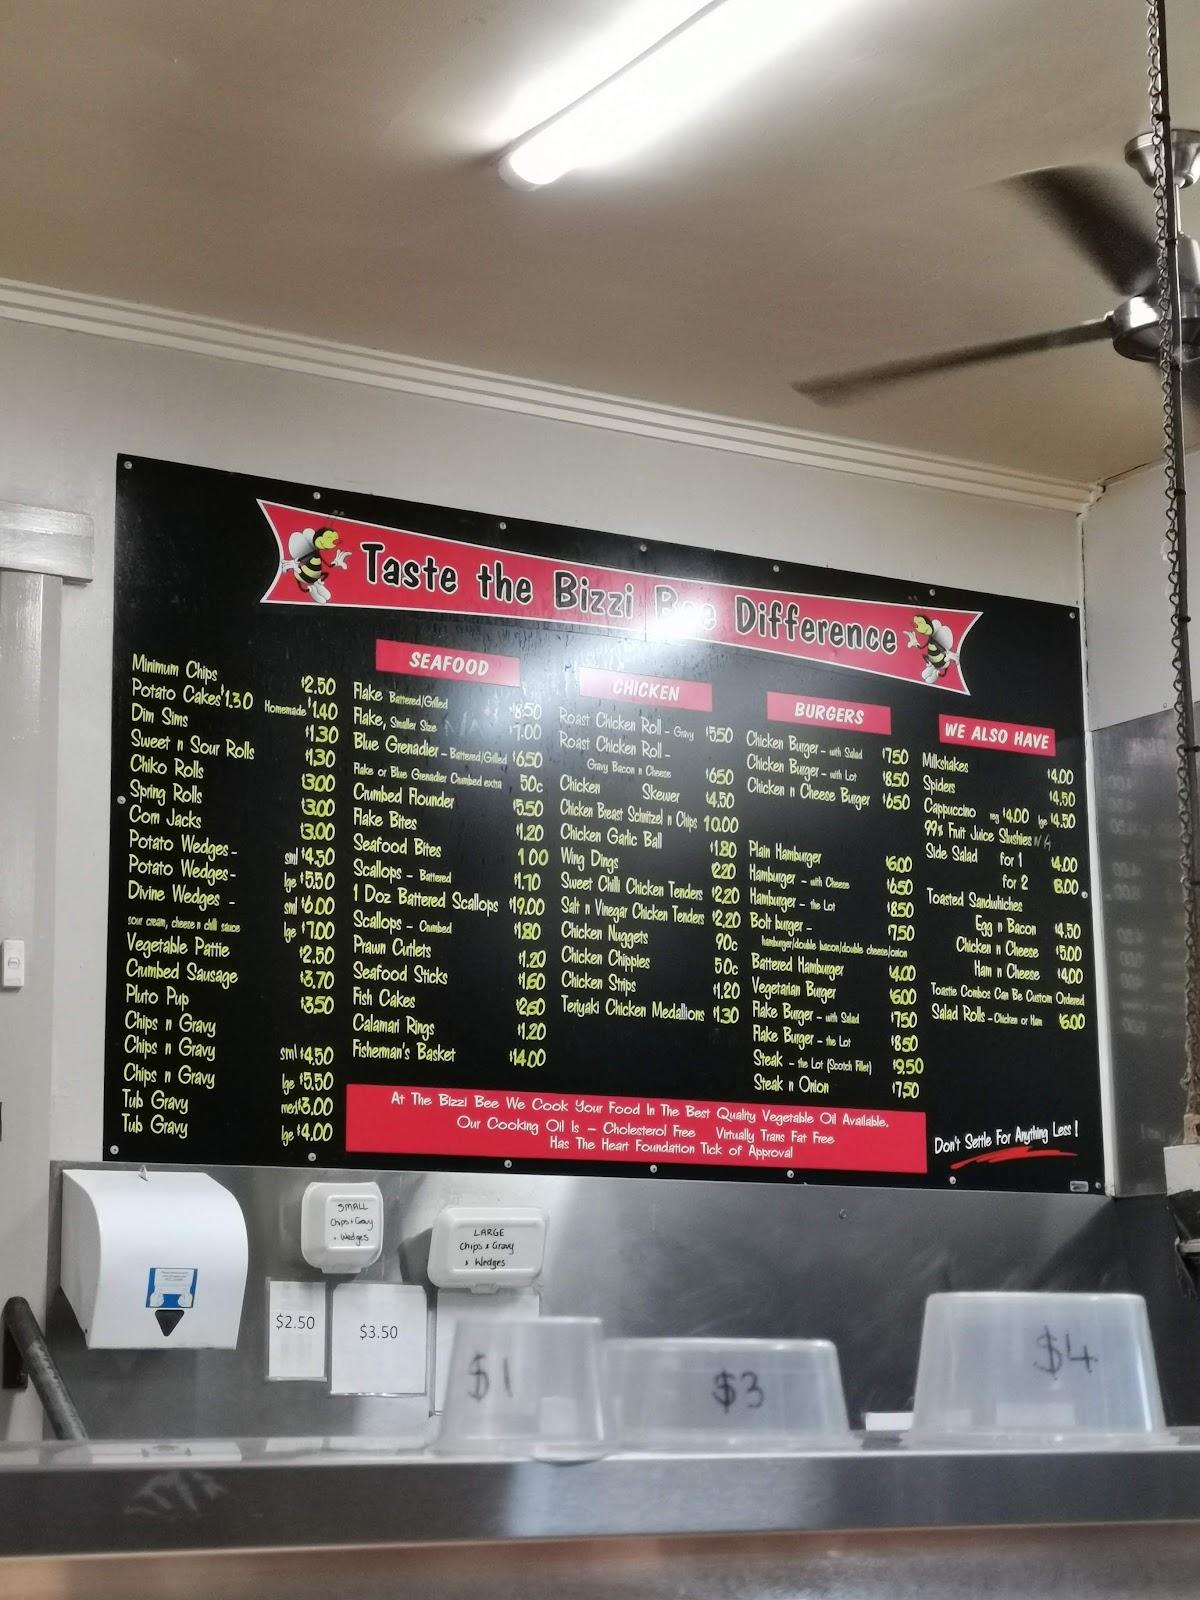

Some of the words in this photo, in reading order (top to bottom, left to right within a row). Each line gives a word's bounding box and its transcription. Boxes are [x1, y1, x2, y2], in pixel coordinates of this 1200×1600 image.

[360, 542, 458, 595] Taste
[477, 560, 533, 606] the
[554, 570, 633, 618] Bizzi
[735, 595, 898, 655] Difference
[132, 653, 179, 677] Minimum
[186, 660, 217, 685] Chips
[301, 675, 336, 695] $2.50
[409, 651, 488, 675] SEAFOOD
[132, 678, 176, 700] Potato
[183, 685, 221, 707] Cakes
[265, 700, 307, 716] Homemade
[308, 696, 338, 720] $1.40
[354, 682, 383, 701] Flake
[612, 678, 680, 702] CHICKEN
[132, 703, 154, 723] Dim
[162, 707, 188, 727] Sims
[795, 702, 864, 724] BURGERS
[131, 728, 171, 750] Sweet
[177, 739, 183, 751] n
[190, 735, 220, 756] Sour
[226, 739, 255, 760] Rolls
[945, 723, 966, 738] WE
[971, 726, 1008, 744] ALSO
[1014, 731, 1049, 749] HAVE
[130, 754, 167, 774] Chiko
[174, 758, 204, 779] Rolls
[923, 752, 968, 773] Milkshakes
[130, 779, 166, 806] Spring
[173, 783, 202, 804] Rolls
[353, 782, 402, 804] Crumbed
[409, 787, 454, 809] Flounder
[560, 774, 600, 794] Chicken
[642, 783, 680, 803] Skewer
[923, 775, 955, 795] Spiders
[924, 797, 976, 819] Cappuccino
[560, 823, 601, 842] Chicken
[607, 827, 637, 846] Garlic
[643, 831, 662, 849] Ball
[749, 840, 770, 858] Plain
[776, 843, 822, 868] Hamburger
[128, 880, 165, 901] Divine
[172, 884, 220, 911] Wedges
[353, 883, 358, 901] 1
[365, 884, 391, 903] Doz
[397, 887, 446, 908] Battered
[452, 891, 498, 917] Scallops
[927, 887, 964, 906] Toasted
[969, 892, 1023, 912] Sandwhiches
[561, 921, 602, 940] Chicken
[608, 924, 648, 949] Nuggets
[716, 933, 738, 951] 90c
[975, 914, 992, 937] Egg
[997, 922, 1002, 932] n
[1006, 918, 1036, 936] Bacon
[127, 932, 188, 958] Vegetable
[195, 936, 230, 957] Pattie
[299, 945, 335, 964] $2.50
[353, 934, 386, 954] Prawn
[392, 938, 431, 958] Cutlets
[126, 958, 179, 979] Crumbed
[187, 962, 238, 989] Sausage
[300, 970, 334, 989] $3.70
[751, 952, 792, 972] Battered
[798, 956, 844, 981] Hamburger
[126, 983, 158, 1004] Pluto
[167, 986, 189, 1012] Pup
[353, 986, 372, 1005] Fish
[379, 989, 415, 1008] Cakes
[752, 976, 800, 1000] Vegetarian
[805, 980, 836, 1004] Burger
[561, 995, 599, 1017] Teriyaki
[605, 998, 646, 1017] Chicken
[652, 1001, 705, 1021] Medallions
[125, 1010, 158, 1035] Chips
[166, 1019, 172, 1031] n
[179, 1013, 216, 1038] Gravy
[353, 1013, 400, 1033] Calamari
[406, 1016, 435, 1041] Rings
[353, 1039, 410, 1060] Fisherman's
[416, 1042, 456, 1062] Basket
[753, 1049, 783, 1067] Steak
[391, 1091, 405, 1104] At
[411, 1092, 432, 1105] The
[474, 1095, 500, 1108] Bee
[506, 1096, 525, 1109] We
[532, 1098, 568, 1111] Cook
[575, 1099, 603, 1113] Your
[608, 1101, 640, 1115] Food
[647, 1103, 655, 1115] In
[660, 1104, 680, 1116] The
[685, 1104, 711, 1118] Best
[717, 1107, 756, 1123] Quality
[762, 1109, 814, 1126] Vegetable
[820, 1112, 836, 1124] Oil
[843, 1113, 888, 1127] Available.
[122, 1113, 143, 1134] Tub
[150, 1114, 188, 1139] Gravy
[457, 1115, 481, 1128] Our
[487, 1117, 538, 1135] Cooking
[546, 1119, 564, 1132] Oil
[572, 1120, 579, 1133] Is
[603, 1122, 666, 1136] Cholesterol
[673, 1125, 696, 1137] Free
[716, 1127, 754, 1143] Virtually
[760, 1129, 785, 1142] Trans
[792, 1130, 807, 1143] Fat
[813, 1131, 835, 1144] Free
[550, 1136, 569, 1149] Has
[576, 1137, 595, 1149] The
[602, 1138, 629, 1151] Heart
[636, 1139, 695, 1154] Foundation
[700, 1142, 722, 1155] Tick
[729, 1145, 743, 1156] of
[749, 1144, 793, 1160] Approval
[934, 1136, 960, 1154] Don't
[965, 1132, 992, 1150] Settle
[996, 1129, 1011, 1146] For
[1015, 1126, 1048, 1145] Anything
[337, 1202, 368, 1212] SMALL
[341, 1232, 369, 1246] Wedges
[474, 1228, 504, 1236] LARGE
[460, 1242, 482, 1254] Chips
[475, 1256, 505, 1270] Wedges
[275, 1313, 315, 1331] $2.50
[359, 1323, 398, 1340] $3.50
[1033, 1324, 1098, 1379] $4
[712, 1369, 764, 1414] $3
